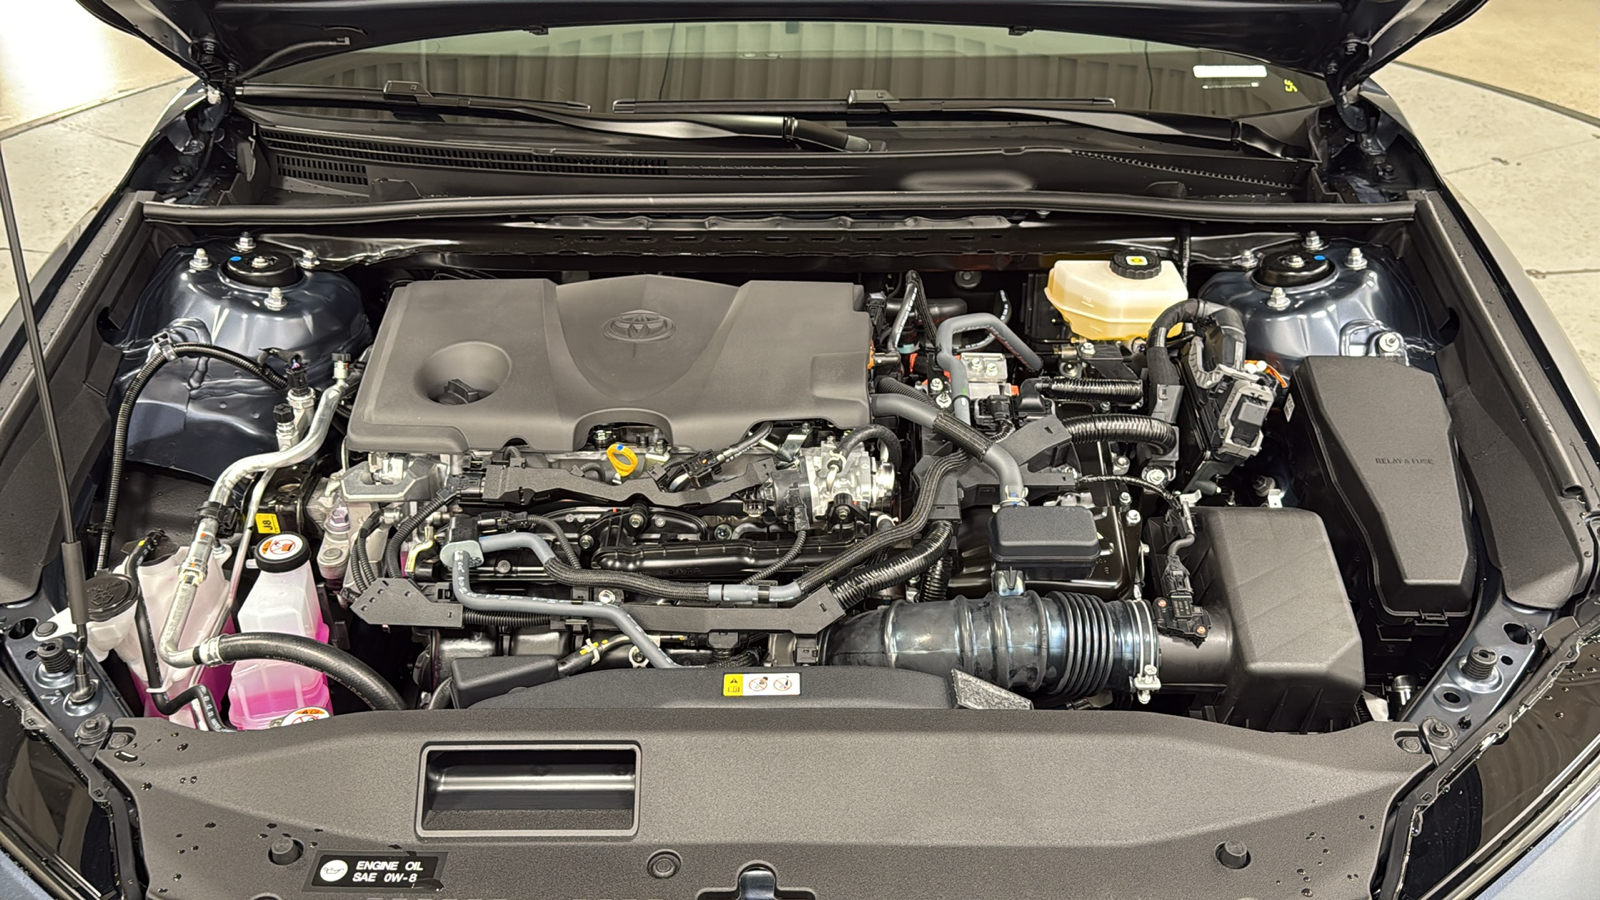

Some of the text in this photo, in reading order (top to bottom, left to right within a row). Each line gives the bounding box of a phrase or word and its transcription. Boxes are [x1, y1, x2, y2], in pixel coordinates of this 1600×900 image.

[356, 861, 423, 870] ENGINE OIL
[352, 873, 377, 882] SAE
